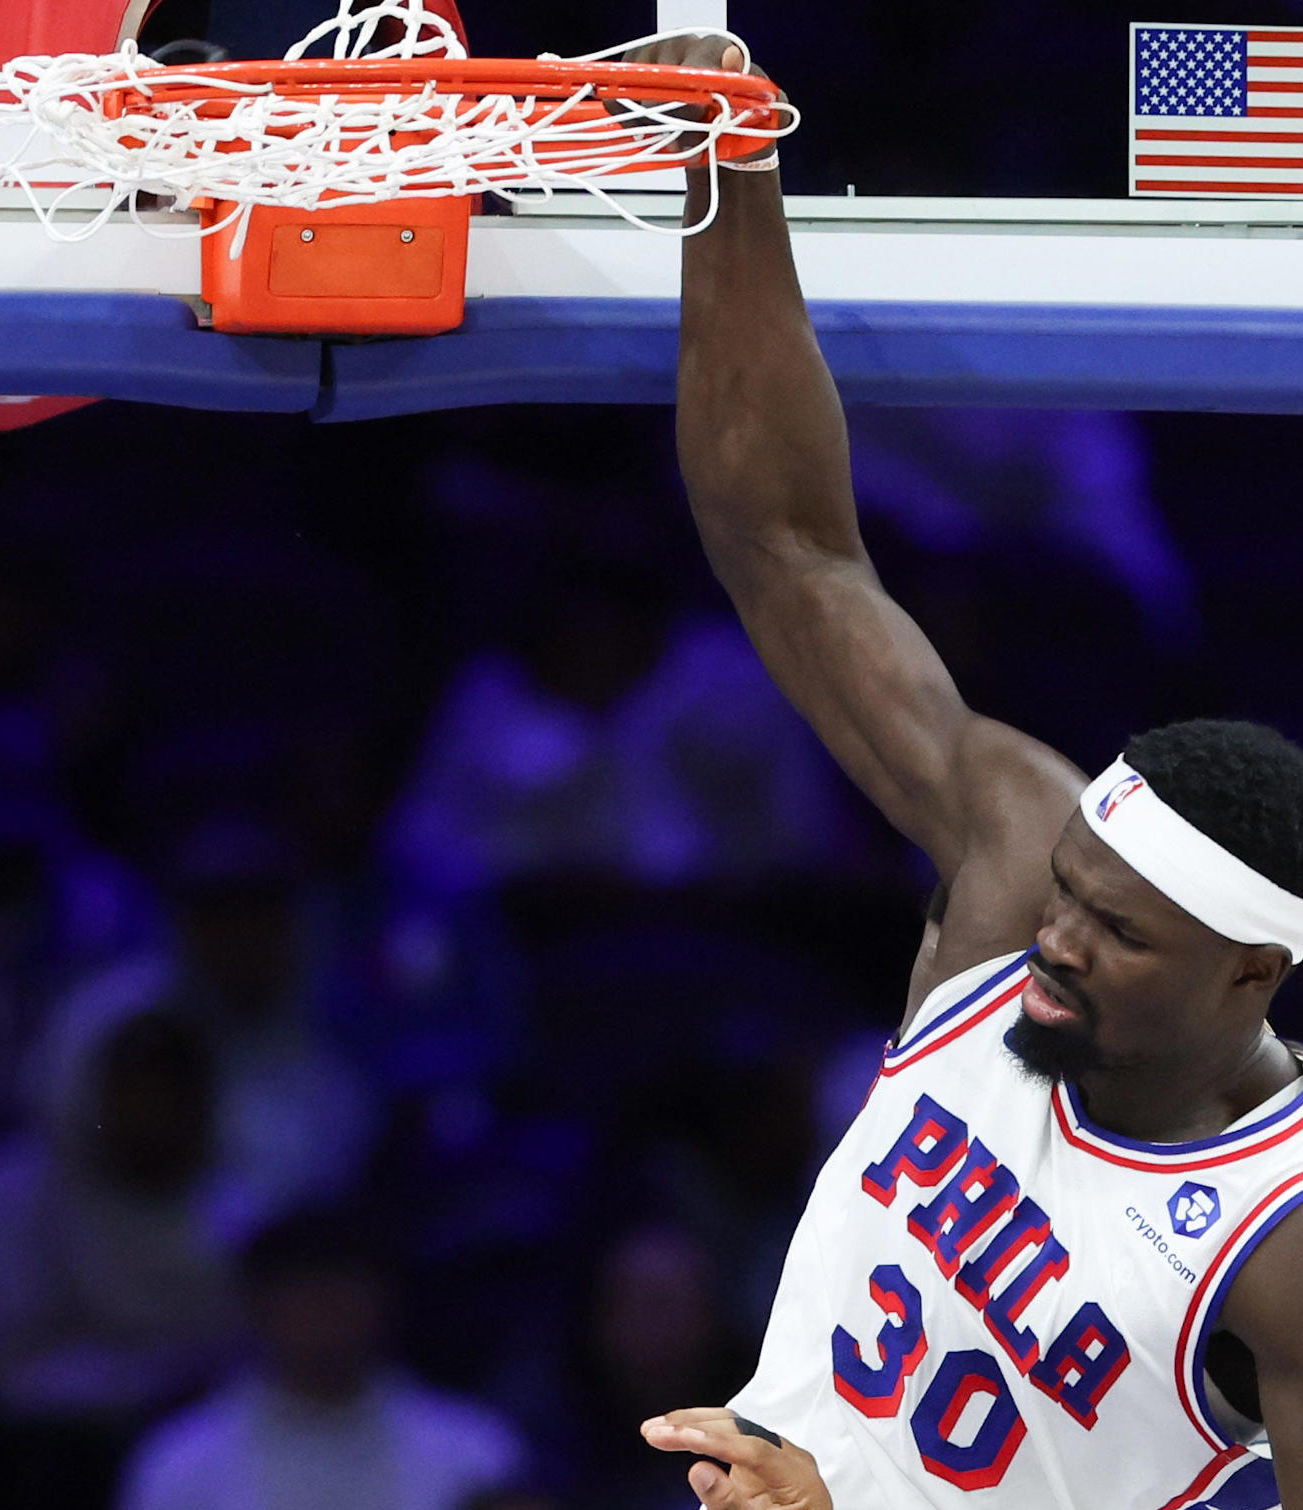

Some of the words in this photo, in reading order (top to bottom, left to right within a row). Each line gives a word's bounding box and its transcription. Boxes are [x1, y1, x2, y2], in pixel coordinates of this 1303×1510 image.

[862, 1093, 1130, 1431] PHILA
[1125, 1206, 1196, 1284] crypto.com
[832, 1264, 1027, 1491] 30
